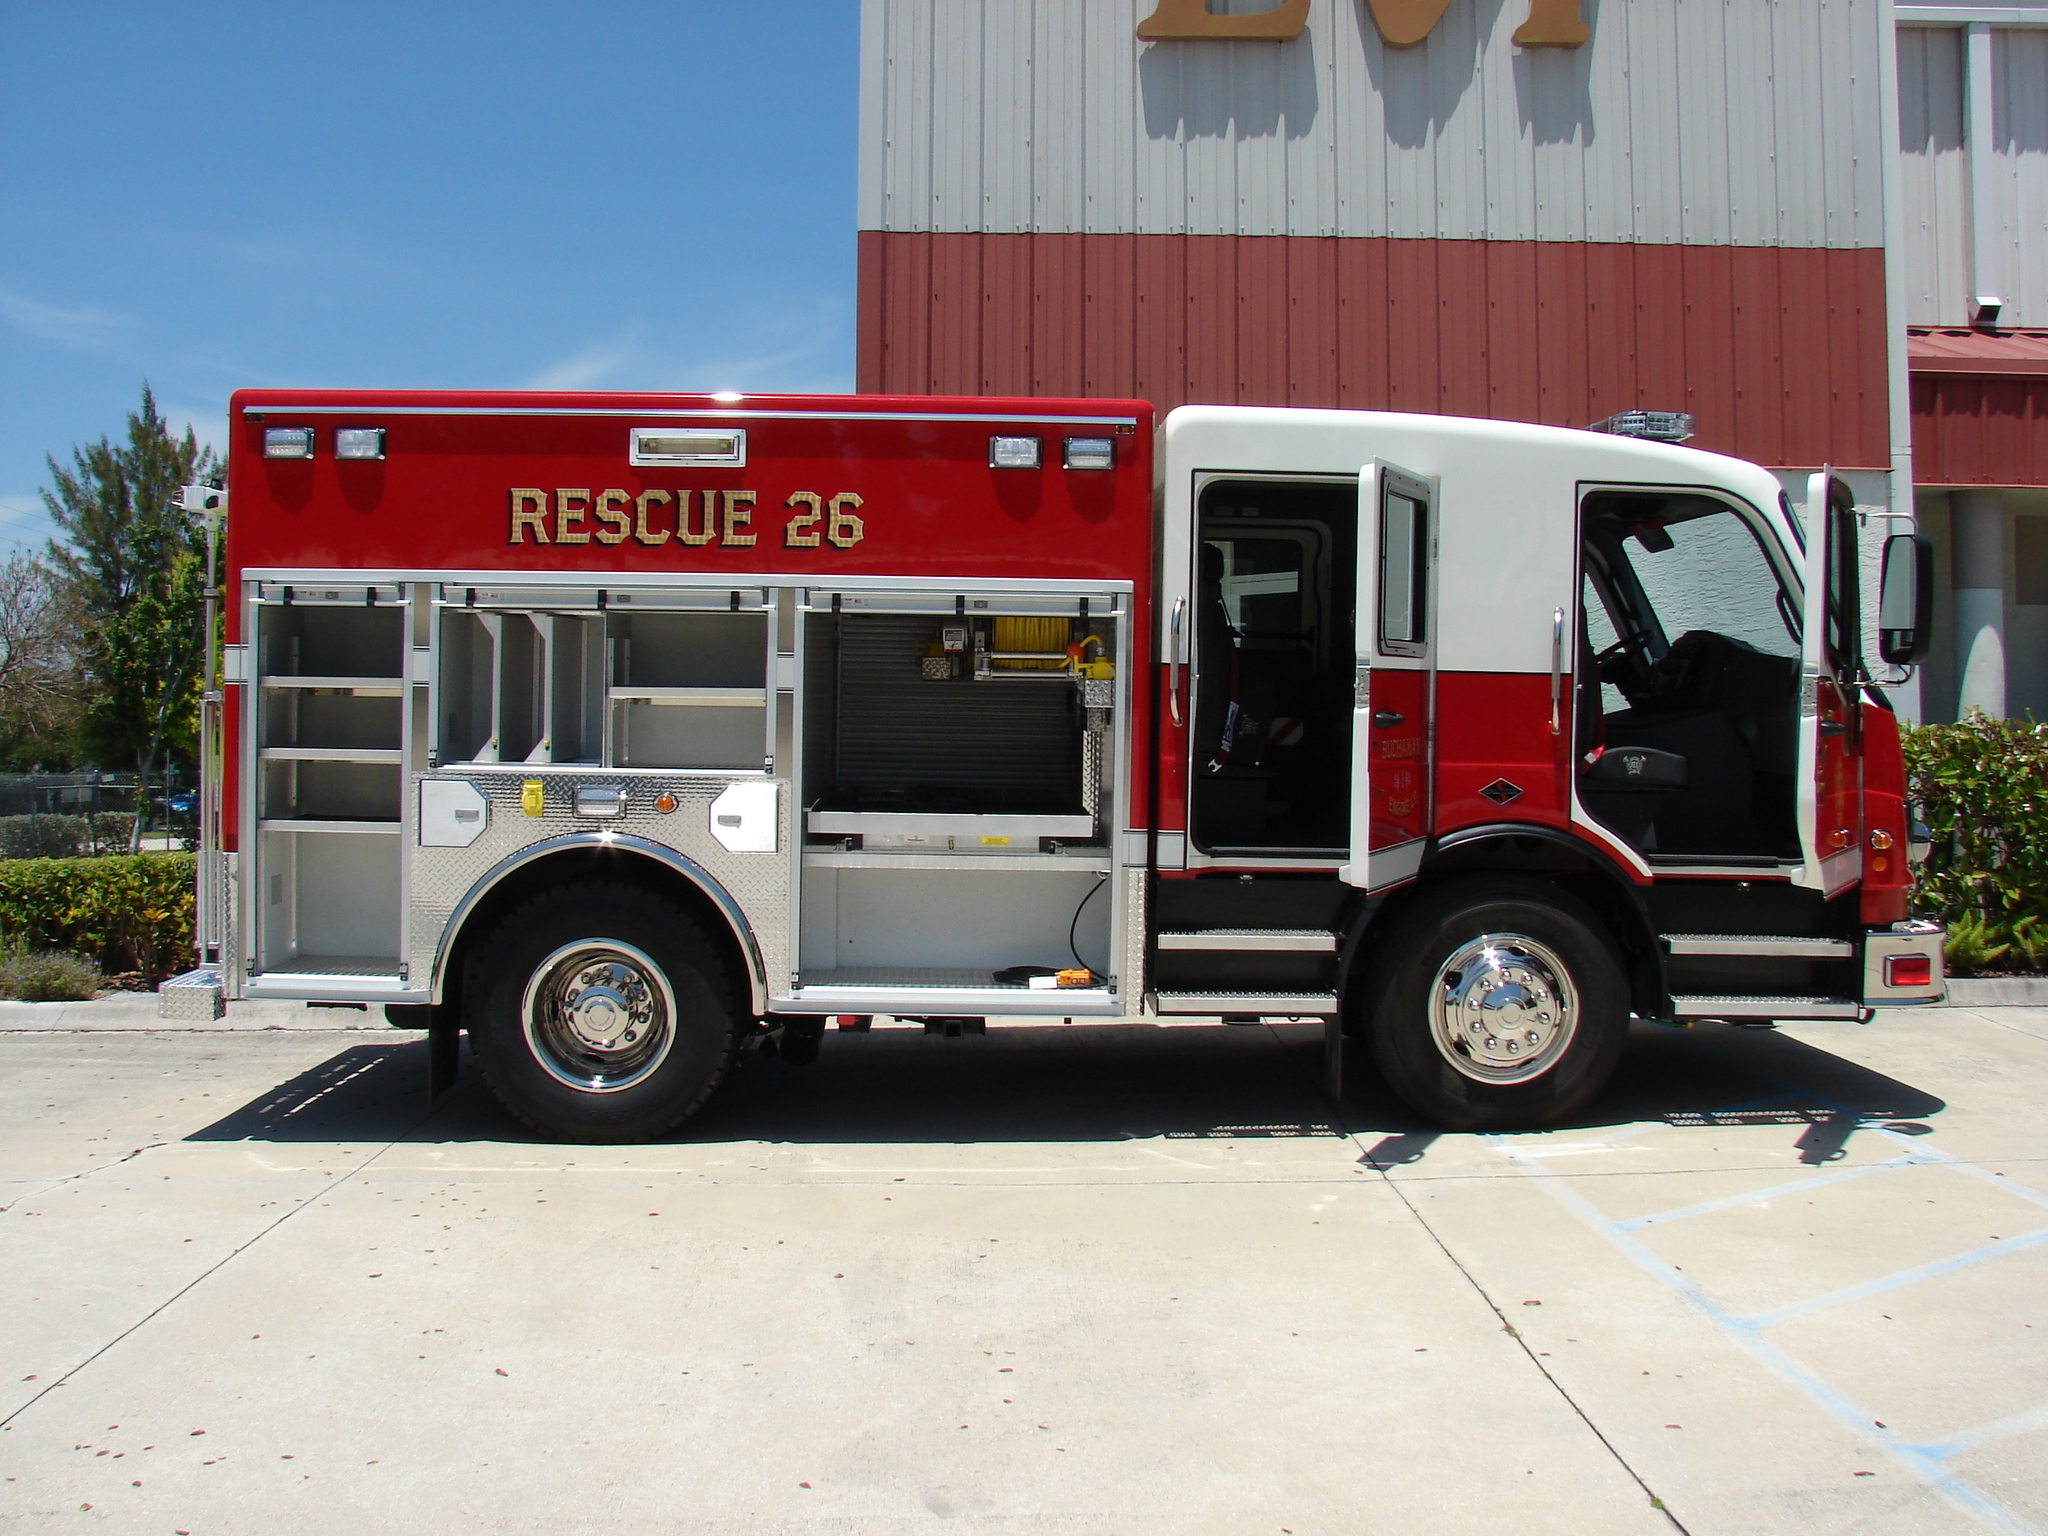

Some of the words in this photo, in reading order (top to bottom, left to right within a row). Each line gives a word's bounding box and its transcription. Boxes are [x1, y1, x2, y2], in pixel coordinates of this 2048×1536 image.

[509, 487, 758, 546] RESCUE
[784, 490, 865, 549] 26
[1382, 737, 1421, 759] BUCHANAN
[1388, 795, 1410, 817] ENGINE
